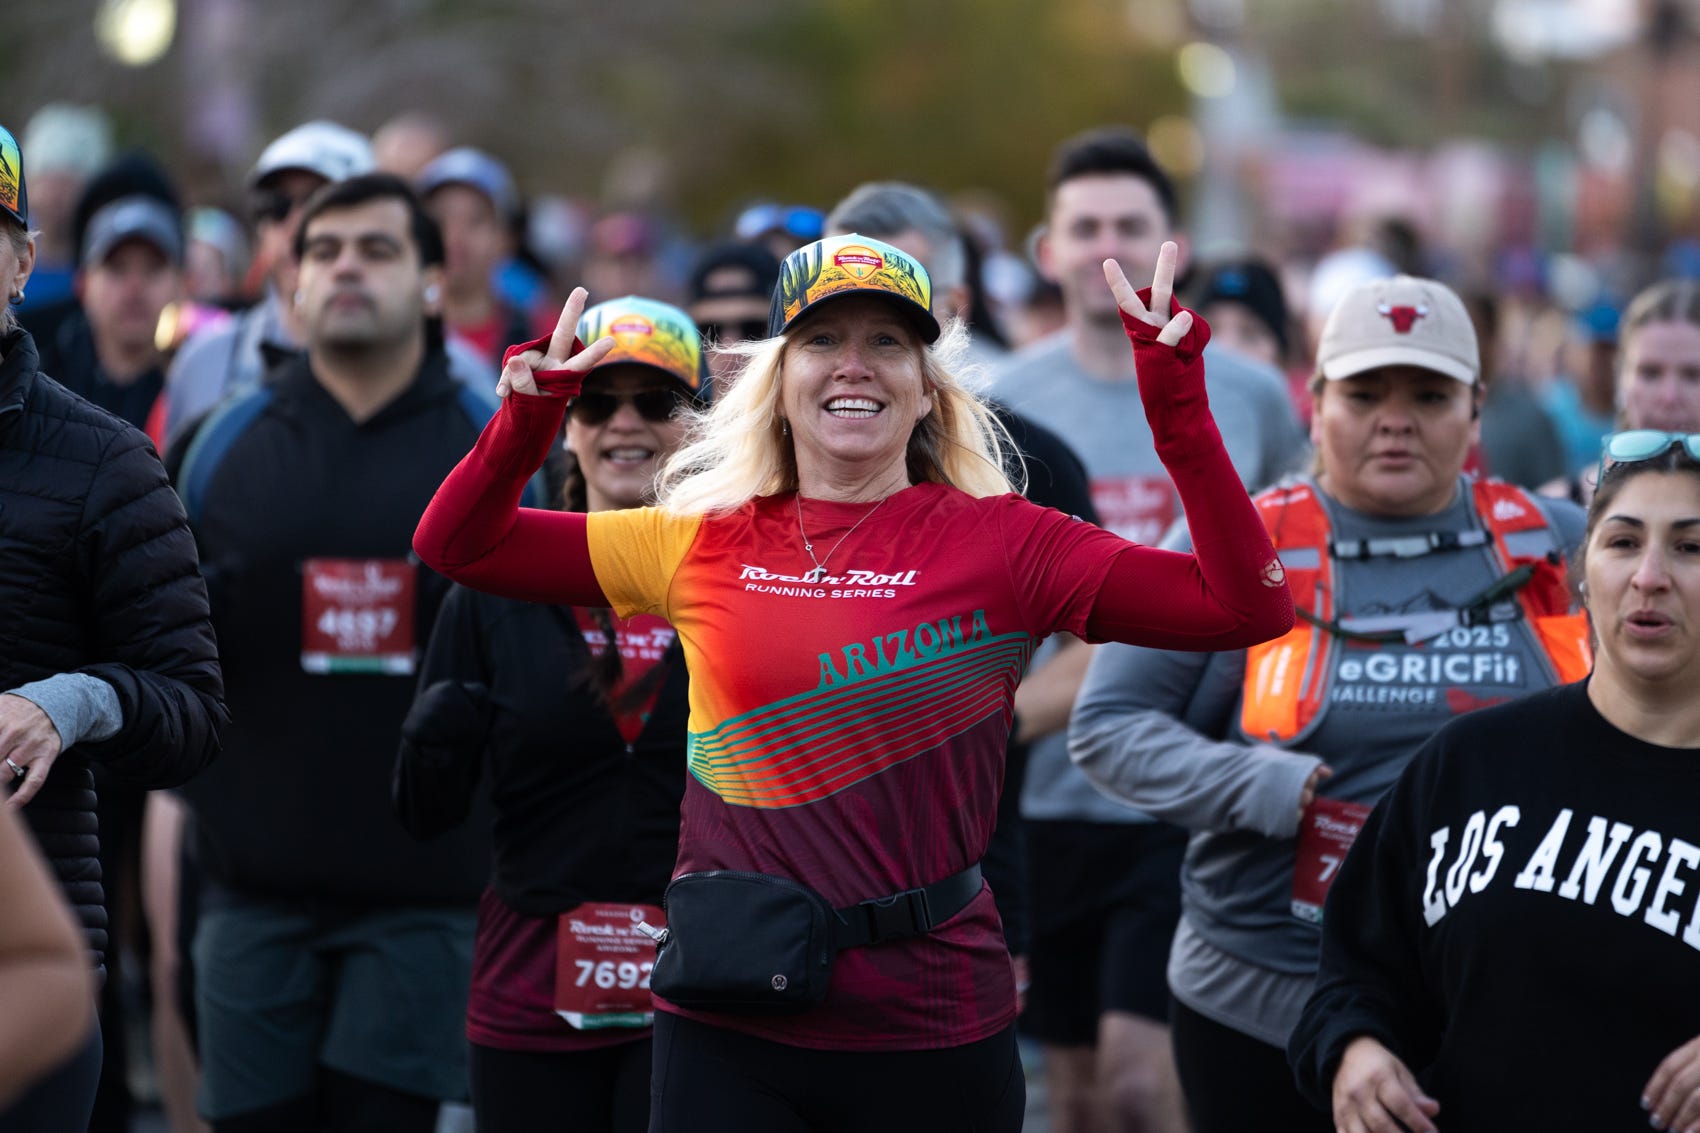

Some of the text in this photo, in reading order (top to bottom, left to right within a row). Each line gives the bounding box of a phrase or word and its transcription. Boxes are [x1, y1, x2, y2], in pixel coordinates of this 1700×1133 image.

[745, 583, 896, 599] RUNNING SERIES
[845, 569, 918, 586] Roll
[817, 609, 993, 690] ARIZONA
[1433, 624, 1510, 649] 2025
[1338, 651, 1519, 684] eGRICFit
[1423, 804, 1521, 928] LOS
[574, 960, 655, 989] 7692
